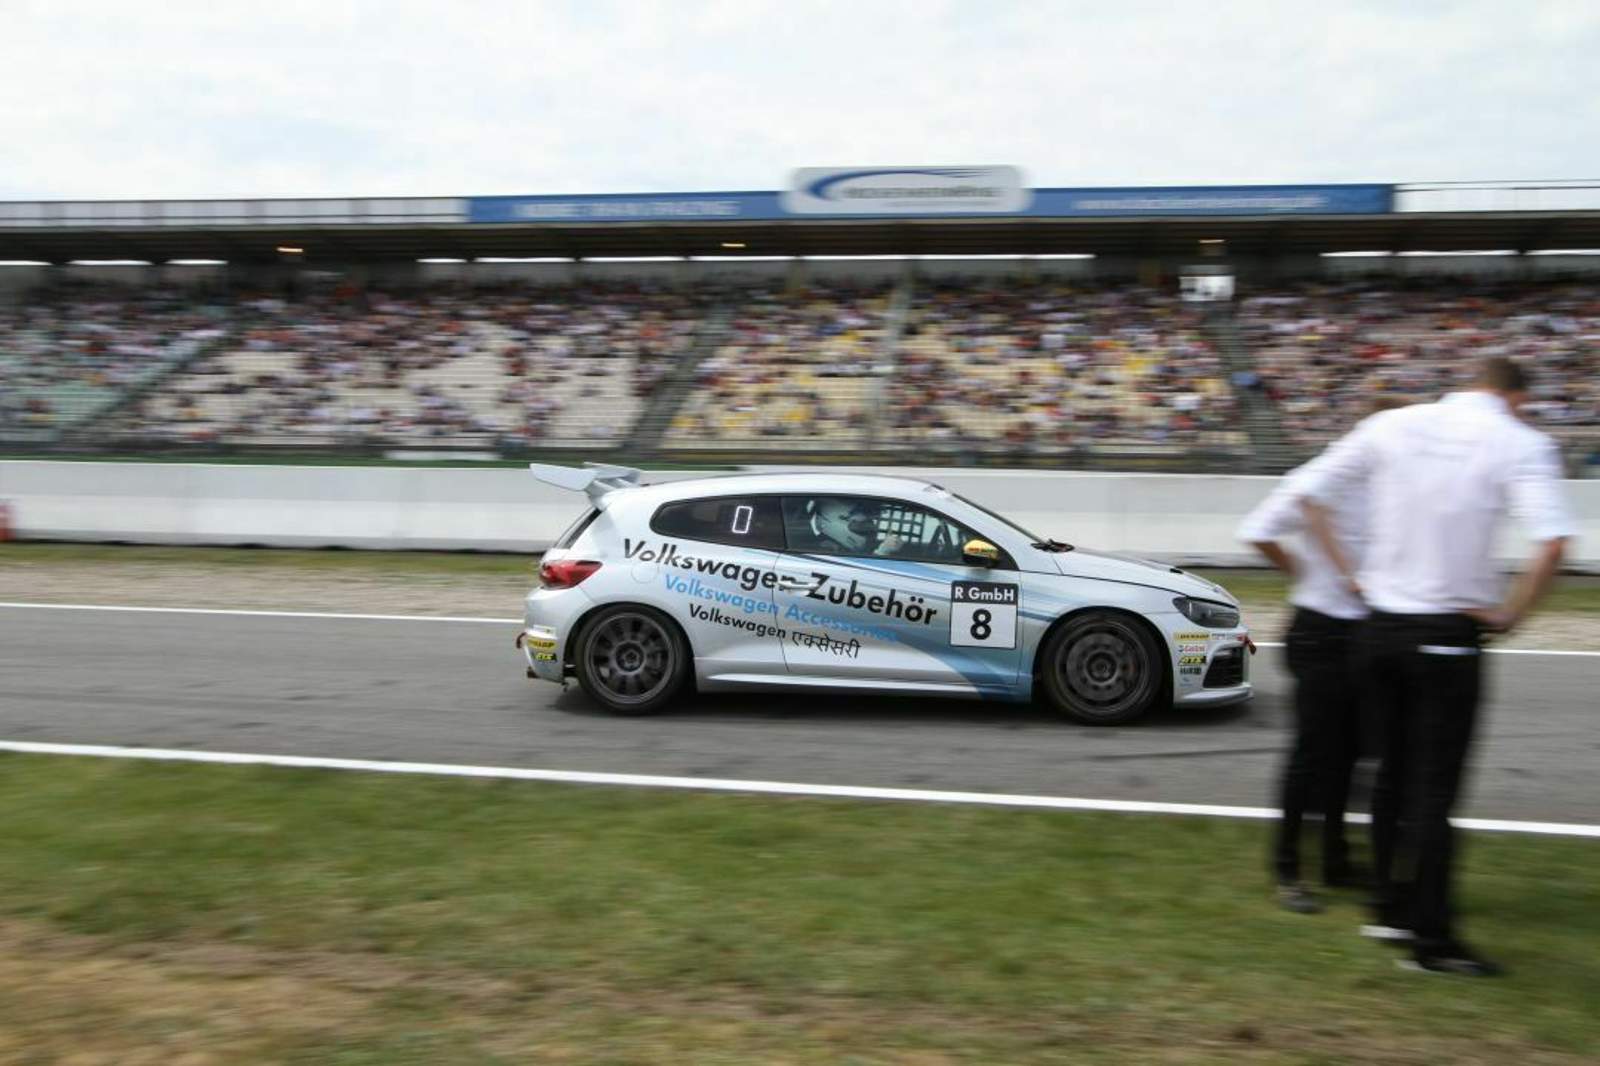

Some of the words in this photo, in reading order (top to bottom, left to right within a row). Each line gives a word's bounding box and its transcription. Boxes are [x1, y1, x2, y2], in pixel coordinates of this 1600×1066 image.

[624, 538, 798, 591] Volkswagen
[806, 572, 937, 625] Zubehör
[665, 573, 780, 616] Volkswagen
[954, 586, 964, 600] R
[968, 586, 1014, 601] GmbH
[690, 603, 786, 638] Volkswagen
[970, 609, 992, 640] 8
